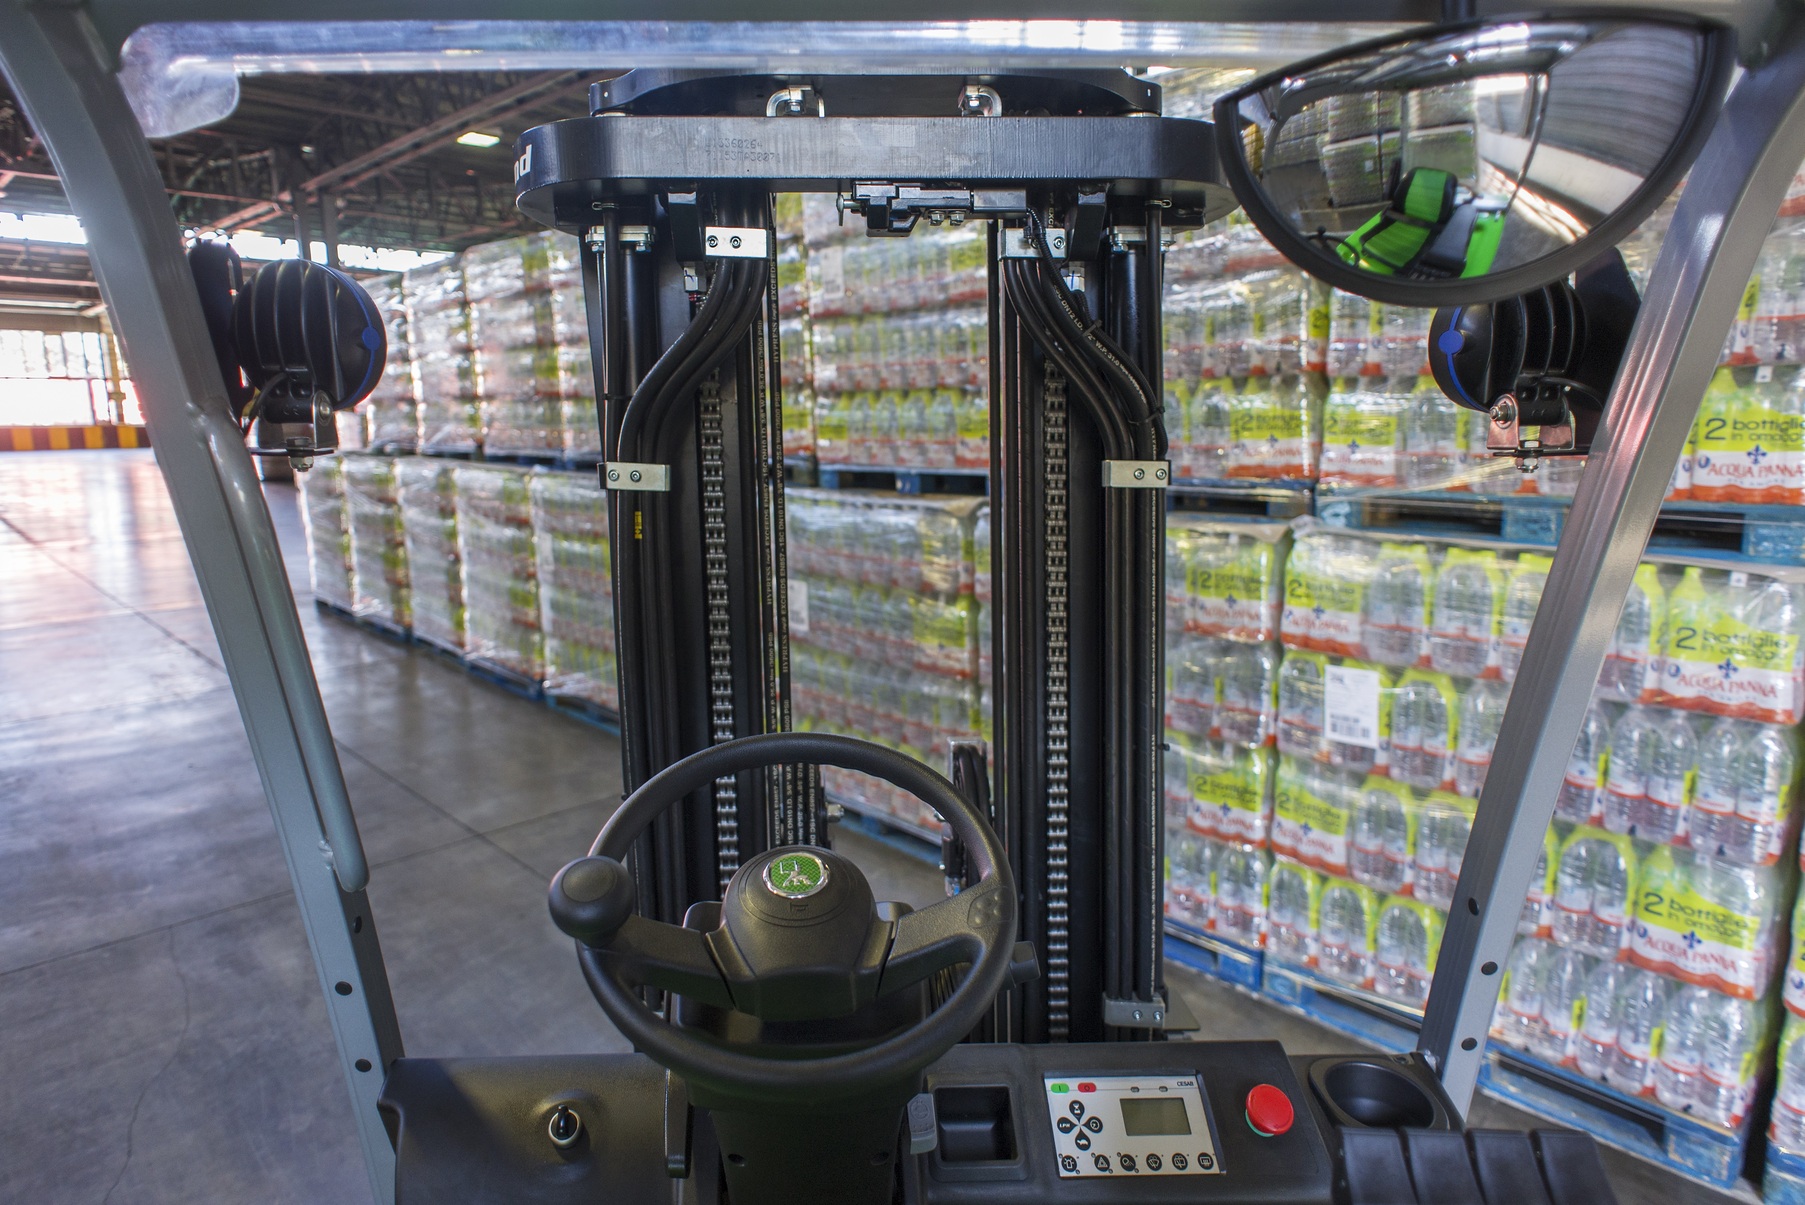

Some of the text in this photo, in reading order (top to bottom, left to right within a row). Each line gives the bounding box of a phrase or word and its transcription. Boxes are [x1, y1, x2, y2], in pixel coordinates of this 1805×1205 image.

[769, 261, 777, 300] EXCEEDS
[772, 322, 780, 363] HYPRESS
[1241, 413, 1254, 431] 2
[1704, 417, 1727, 440] 2
[1733, 417, 1805, 433] bottiglie
[1707, 463, 1804, 479] ACQUA PANNA
[763, 508, 771, 546] EXCEEDS
[1199, 571, 1212, 590] 2
[1289, 579, 1303, 598] 2
[1675, 626, 1697, 650] 2
[1702, 628, 1789, 649] bottiglie
[781, 634, 789, 673] HYPRESS
[1676, 673, 1726, 692] ACQUA
[1728, 680, 1778, 698] PANNA
[1195, 775, 1208, 794] 2
[1277, 791, 1290, 812] 2
[1643, 892, 1750, 929] 2 bottiglie
[1644, 935, 1689, 960] ACQUA
[1691, 948, 1738, 974] PANNA
